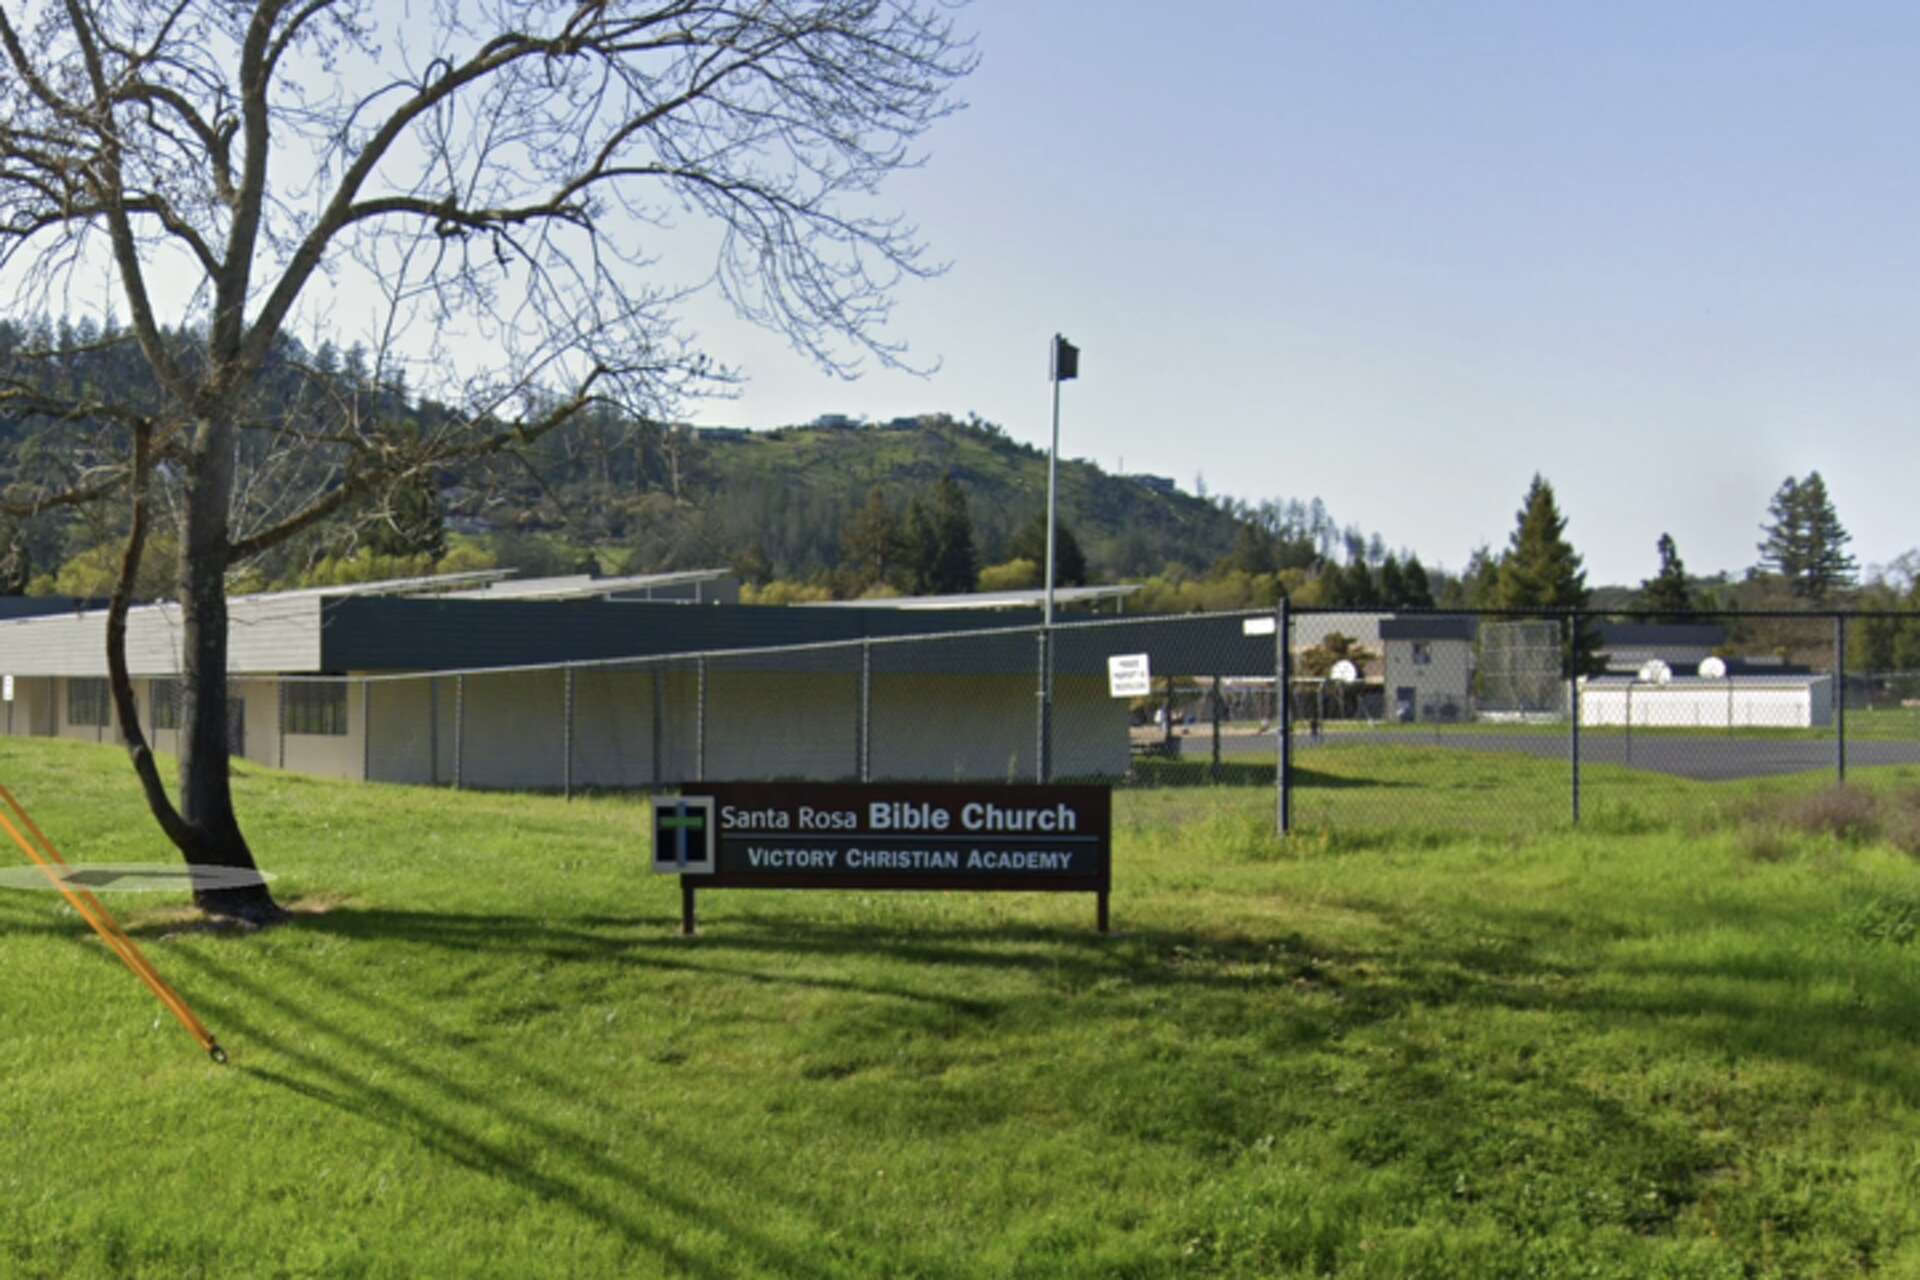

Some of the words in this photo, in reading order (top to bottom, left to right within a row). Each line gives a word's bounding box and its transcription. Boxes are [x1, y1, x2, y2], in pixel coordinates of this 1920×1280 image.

[721, 805, 790, 829] Santa
[798, 806, 857, 829] Rosa
[869, 802, 950, 830] Bible
[961, 802, 1077, 831] Church
[747, 847, 837, 867] VICTORY
[845, 848, 959, 869] CHRISTIAN
[967, 849, 1073, 869] ACADEMY
